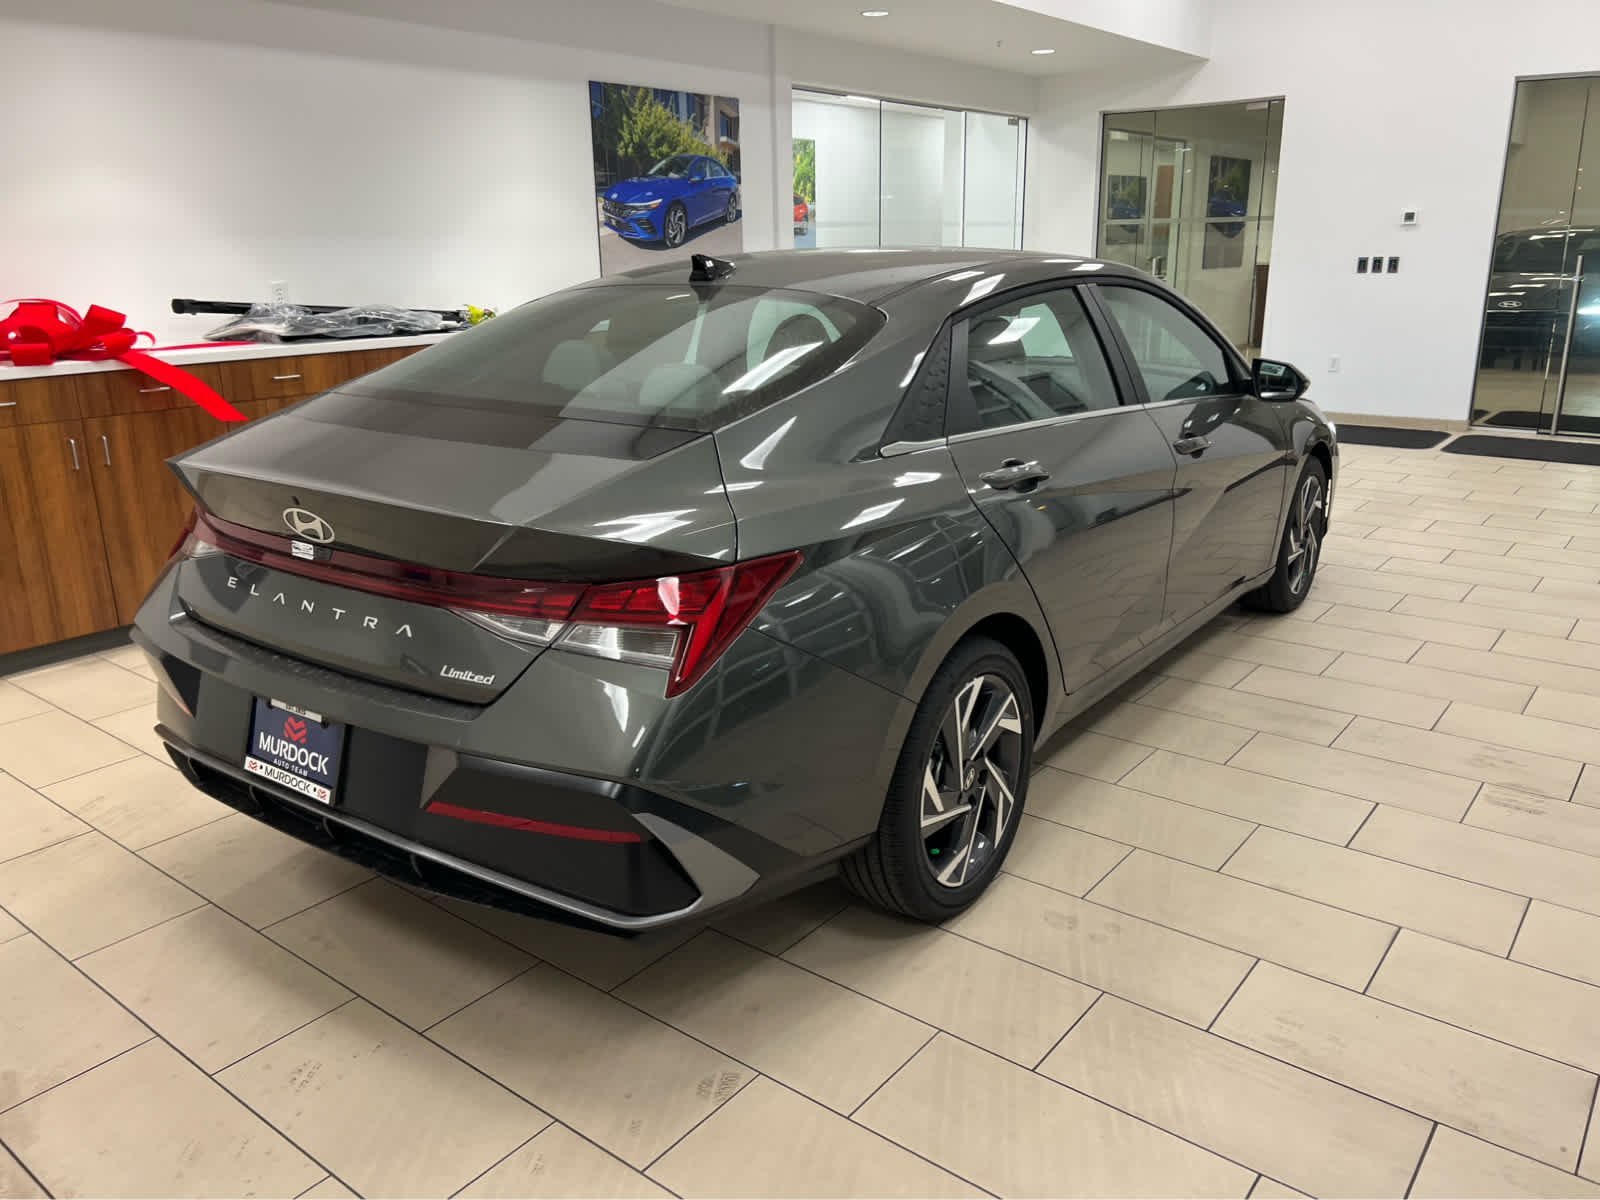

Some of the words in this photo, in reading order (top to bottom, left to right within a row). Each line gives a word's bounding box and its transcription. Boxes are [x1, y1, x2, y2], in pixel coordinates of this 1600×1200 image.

[227, 576, 412, 638] ELANTRA
[439, 664, 495, 685] Limited
[259, 731, 329, 775] MURDOCK
[264, 765, 311, 793] MURDOCK
[273, 758, 290, 770] AUTO
[290, 764, 308, 777] TEAM
